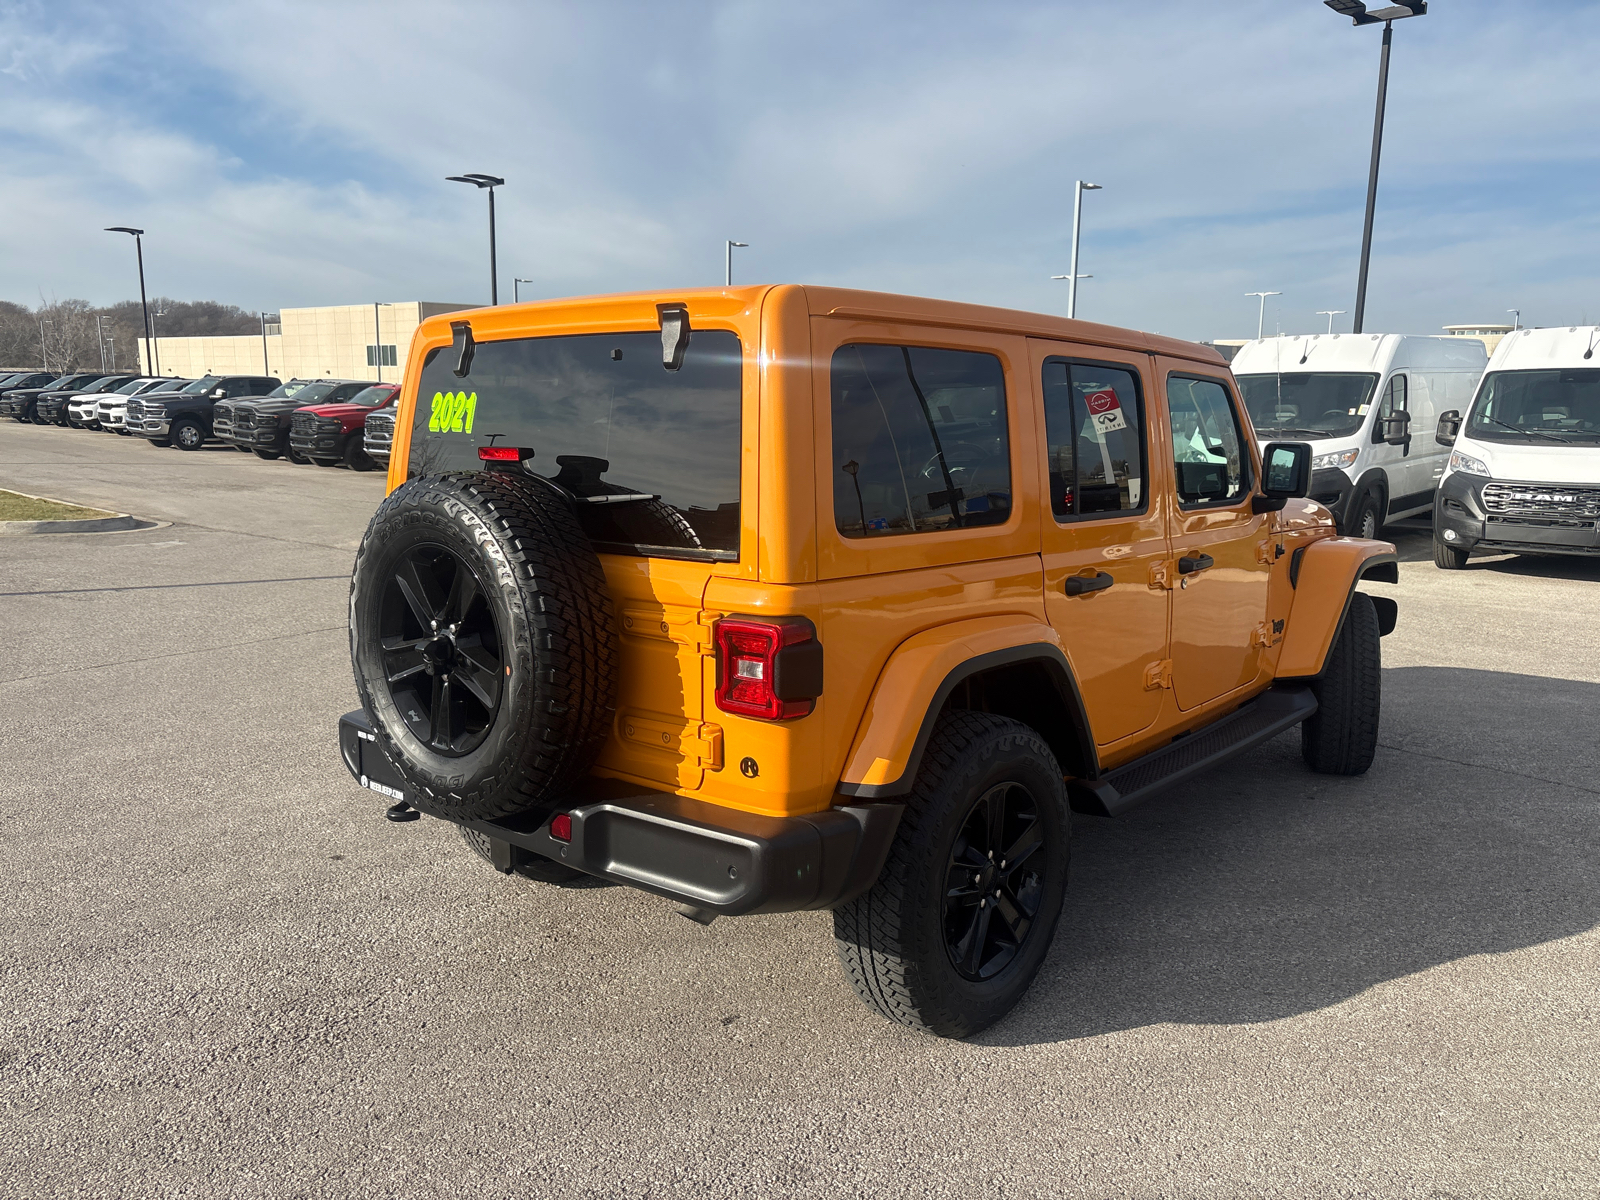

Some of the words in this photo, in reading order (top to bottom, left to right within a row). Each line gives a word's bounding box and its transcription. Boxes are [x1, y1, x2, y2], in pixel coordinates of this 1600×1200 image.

[428, 391, 478, 434] 2021
[1514, 493, 1573, 502] RAM
[378, 510, 501, 598] BRIDGESTONE
